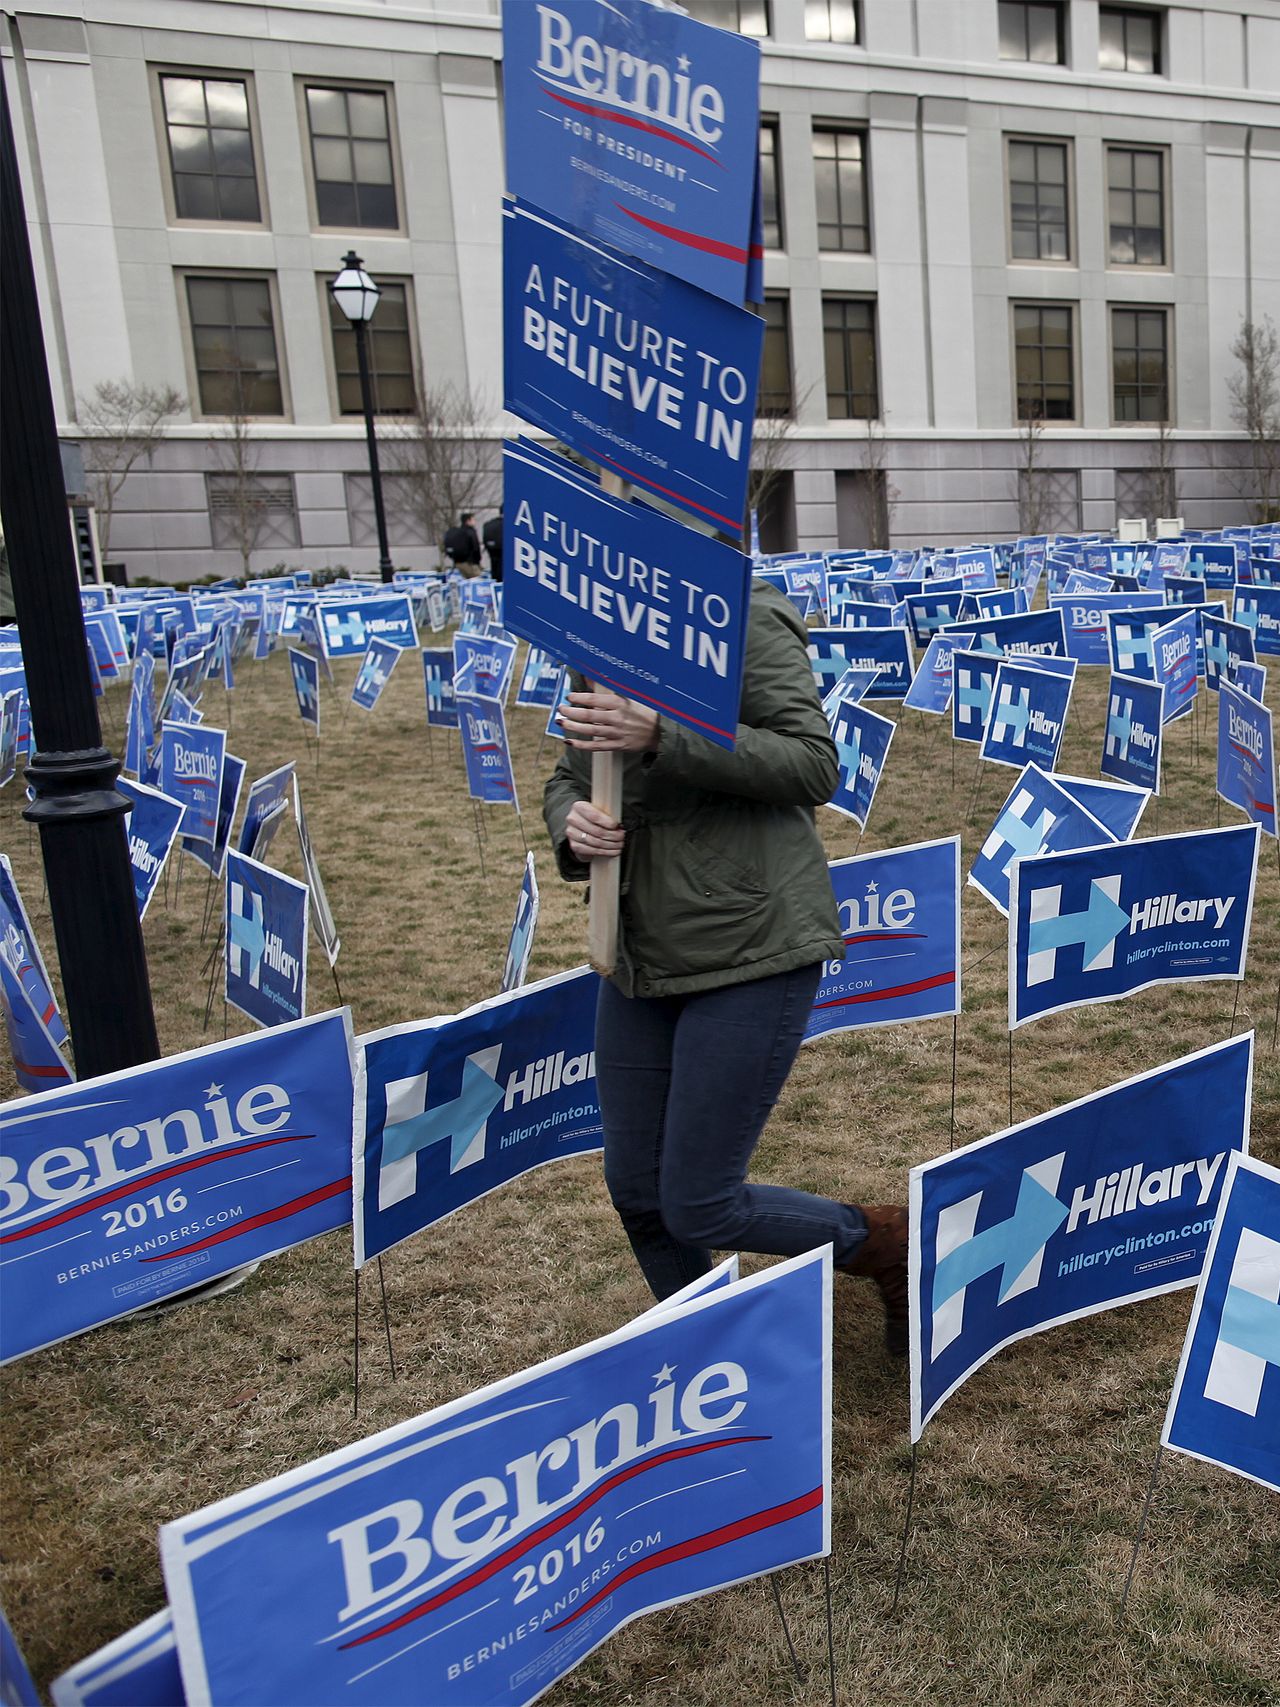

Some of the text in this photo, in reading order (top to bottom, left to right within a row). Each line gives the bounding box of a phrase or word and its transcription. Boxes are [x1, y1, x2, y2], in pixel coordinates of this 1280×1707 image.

[535, 4, 725, 143] Bernie
[563, 117, 687, 182] FOR PRESIDENT
[570, 156, 677, 213] BERNIESANDERS.COM
[525, 264, 747, 405] A FUTURE TO
[523, 305, 685, 431] BELIEVE
[695, 400, 743, 461] IN
[571, 410, 668, 470] BERNIESANDERS.COM
[514, 500, 730, 628] A FUTURE TO
[1205, 562, 1233, 576] Hillary
[513, 537, 671, 649] BELIEVE
[683, 625, 728, 678] IN
[565, 631, 660, 685] BERNIESANDERS.COM
[1162, 631, 1191, 668] Bernie
[1029, 709, 1060, 743] Hillary
[1130, 721, 1157, 757] Hillary
[1229, 704, 1263, 760] Bernie
[173, 743, 217, 781] Bernie
[838, 879, 916, 937] nie
[1128, 892, 1236, 936] Hillary
[264, 930, 299, 993] Hillary
[1126, 938, 1230, 965] hillaryclinton.com
[101, 1187, 188, 1238] 2016
[1065, 1151, 1227, 1234] Hillary
[57, 1205, 243, 1285] BERNIESANDERS.COM
[1057, 1216, 1218, 1279] hillaryclinton.com
[326, 1361, 749, 1624] Bernie
[512, 1515, 605, 1605] 2016
[447, 1530, 662, 1681] BERNIESANDERS.COM
